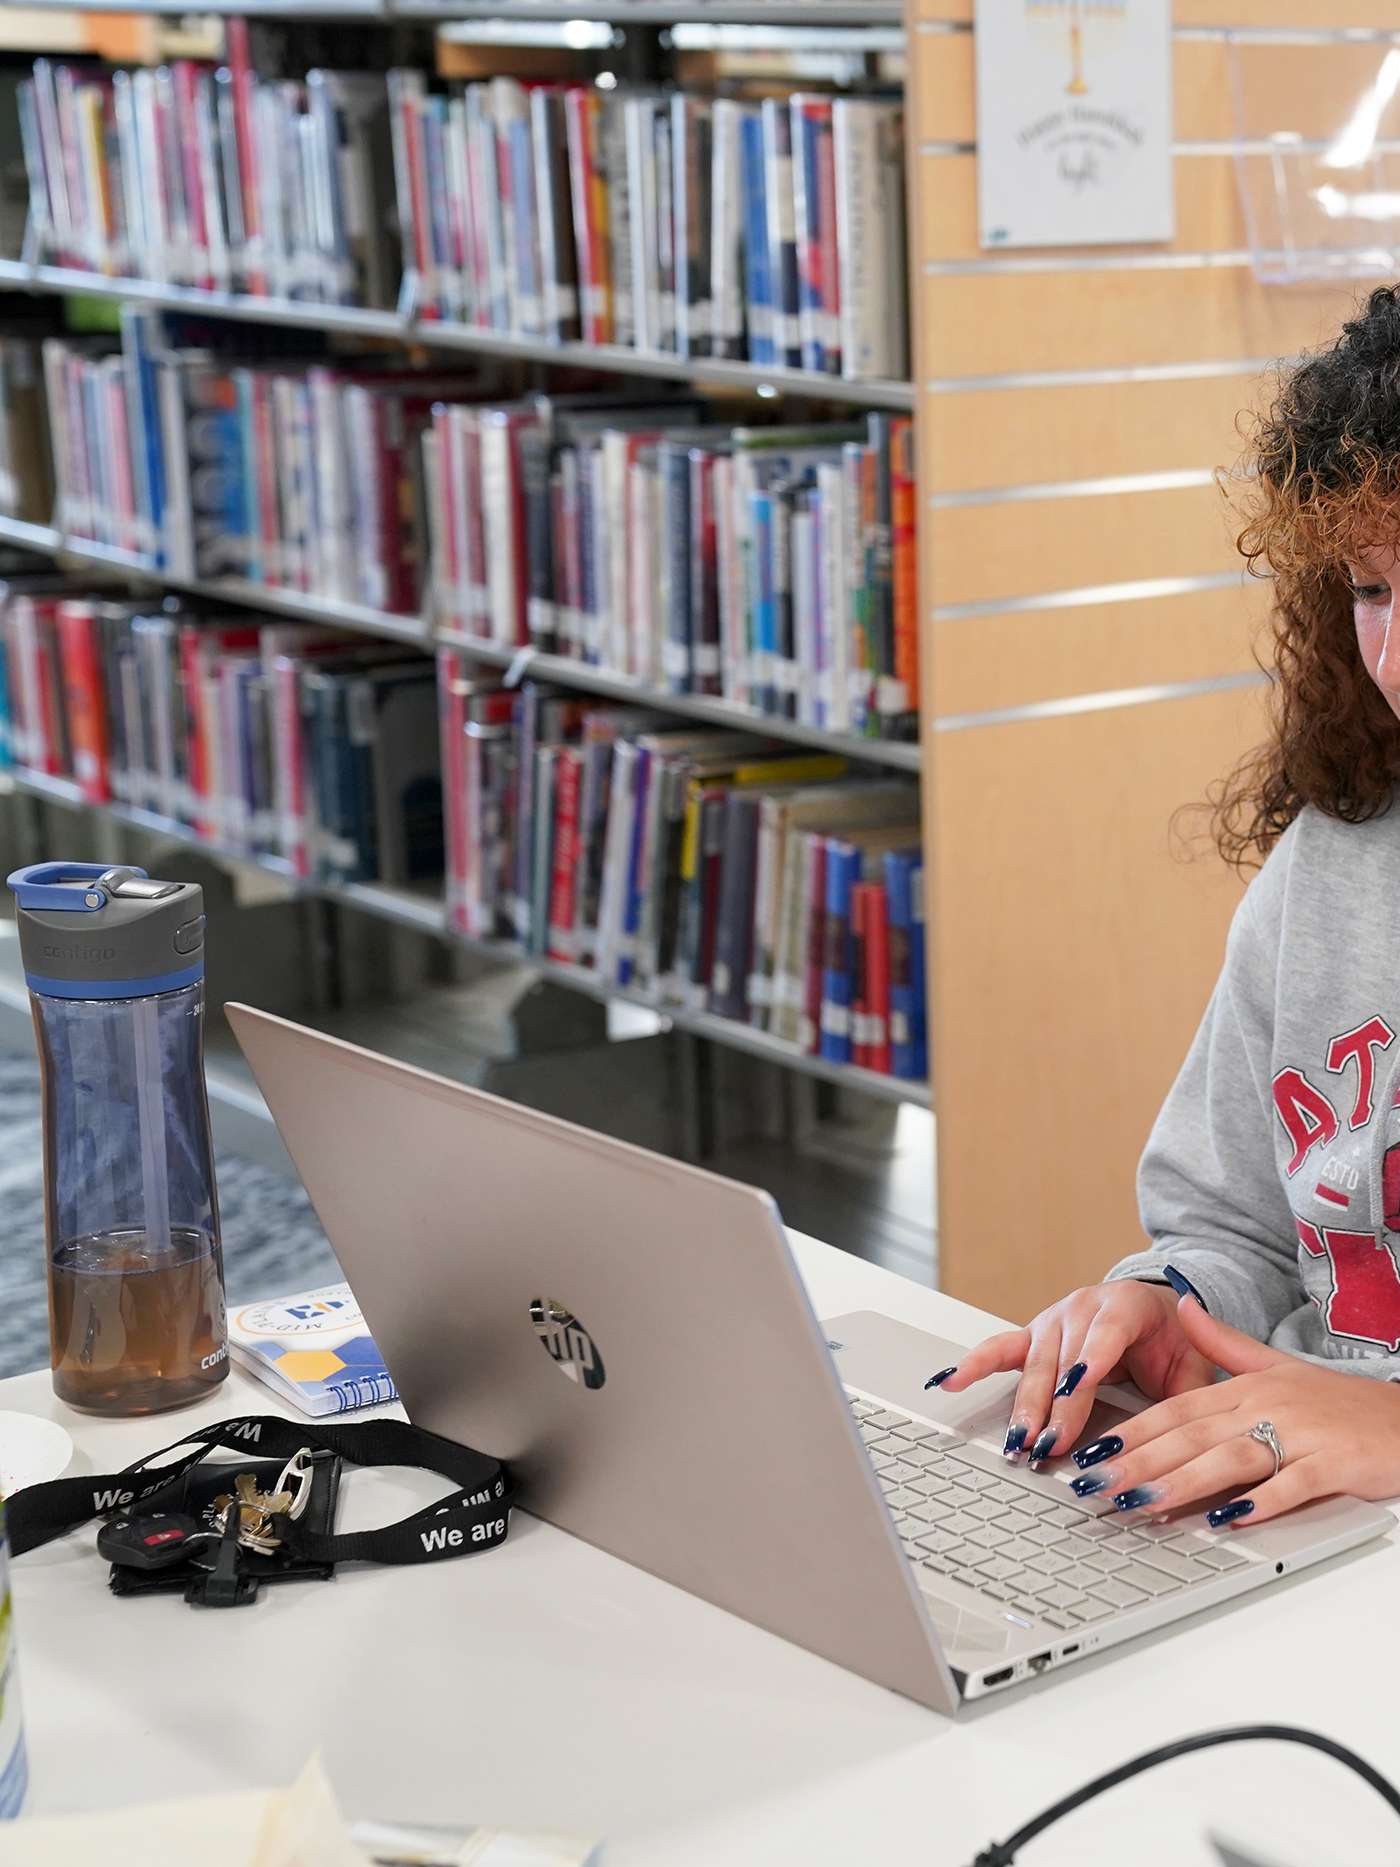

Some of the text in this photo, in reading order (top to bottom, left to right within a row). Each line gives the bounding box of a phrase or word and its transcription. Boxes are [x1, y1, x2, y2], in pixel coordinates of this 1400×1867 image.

[1320, 1155, 1360, 1191] ESTD
[528, 1297, 607, 1391] hp
[92, 1488, 135, 1512] We
[420, 1518, 506, 1553] We are
